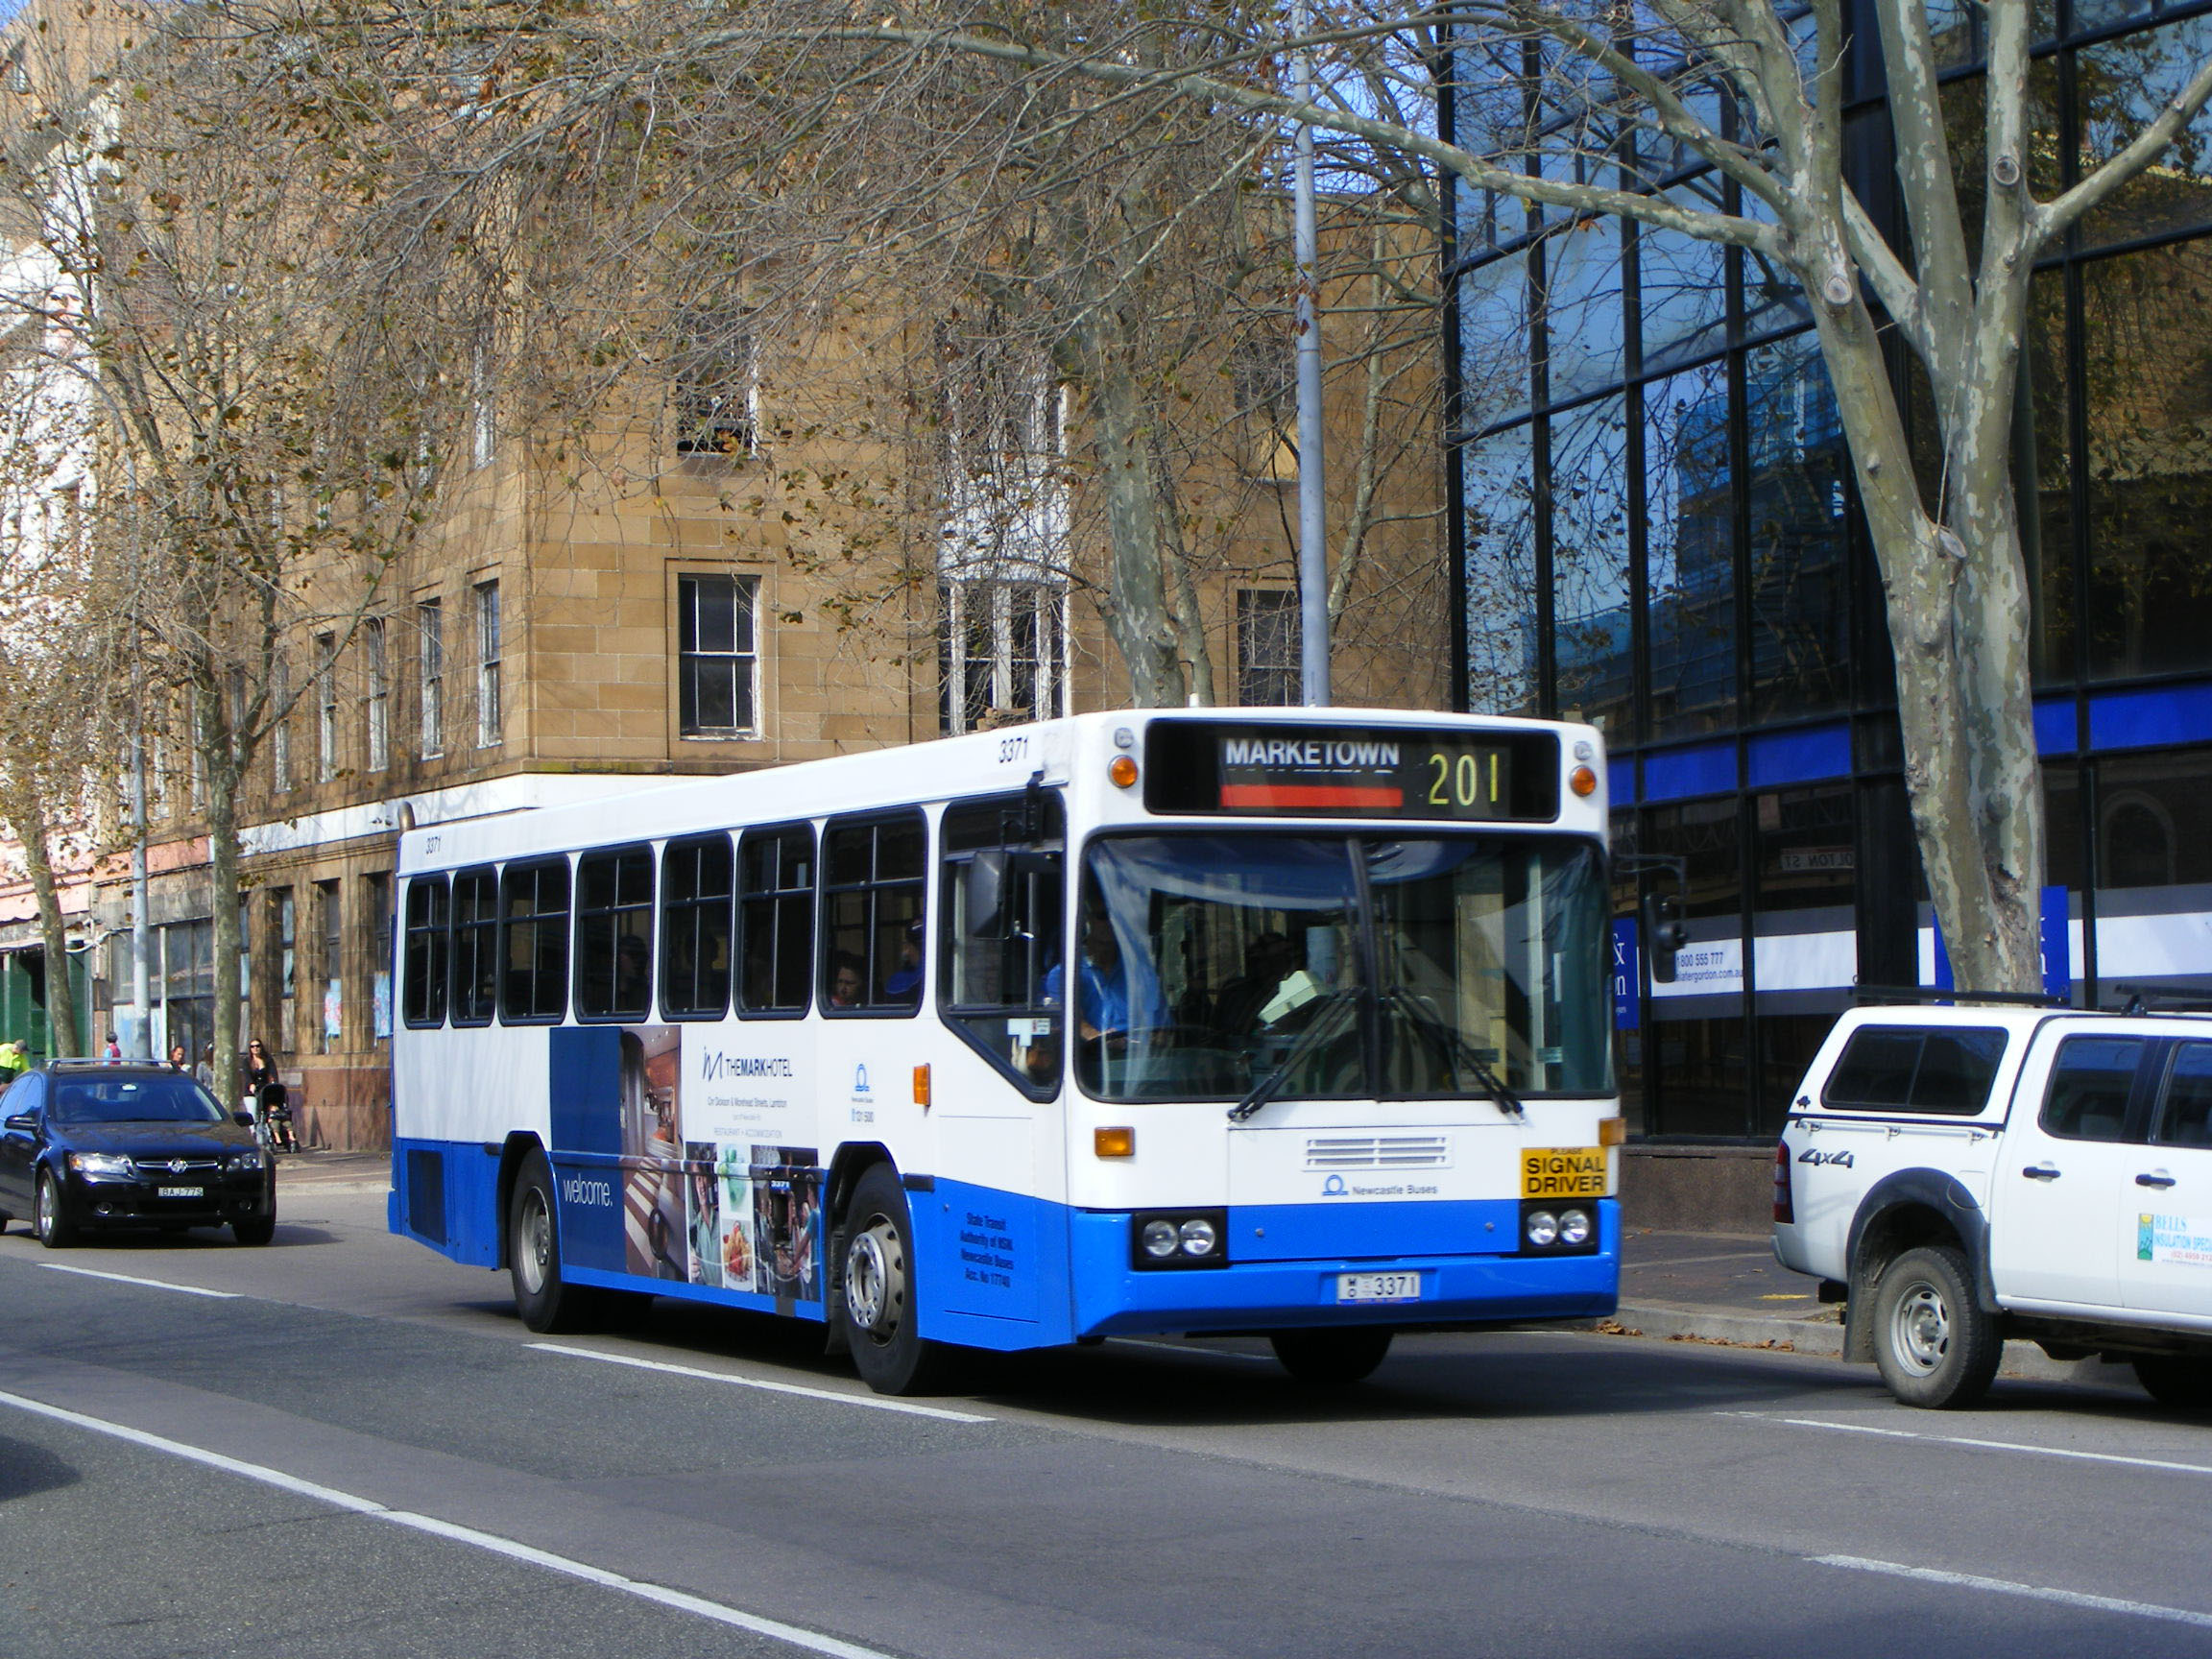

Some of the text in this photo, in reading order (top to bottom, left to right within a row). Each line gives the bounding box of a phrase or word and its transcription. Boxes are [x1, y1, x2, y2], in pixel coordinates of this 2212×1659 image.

[999, 735, 1028, 763] 3371
[1225, 738, 1498, 805] MARKETOWN 201
[1695, 953, 1709, 967] 555
[1710, 951, 1724, 966] 777
[1527, 1156, 1604, 1174] SIGNAL
[1797, 1147, 1854, 1168] 4x4
[563, 1172, 613, 1207] welcome.
[1352, 1185, 1437, 1195] Newcastle Buses
[1527, 1175, 1604, 1193] DRIVER
[2155, 1214, 2187, 1231] BELLS
[1374, 1275, 1416, 1296] 3371
